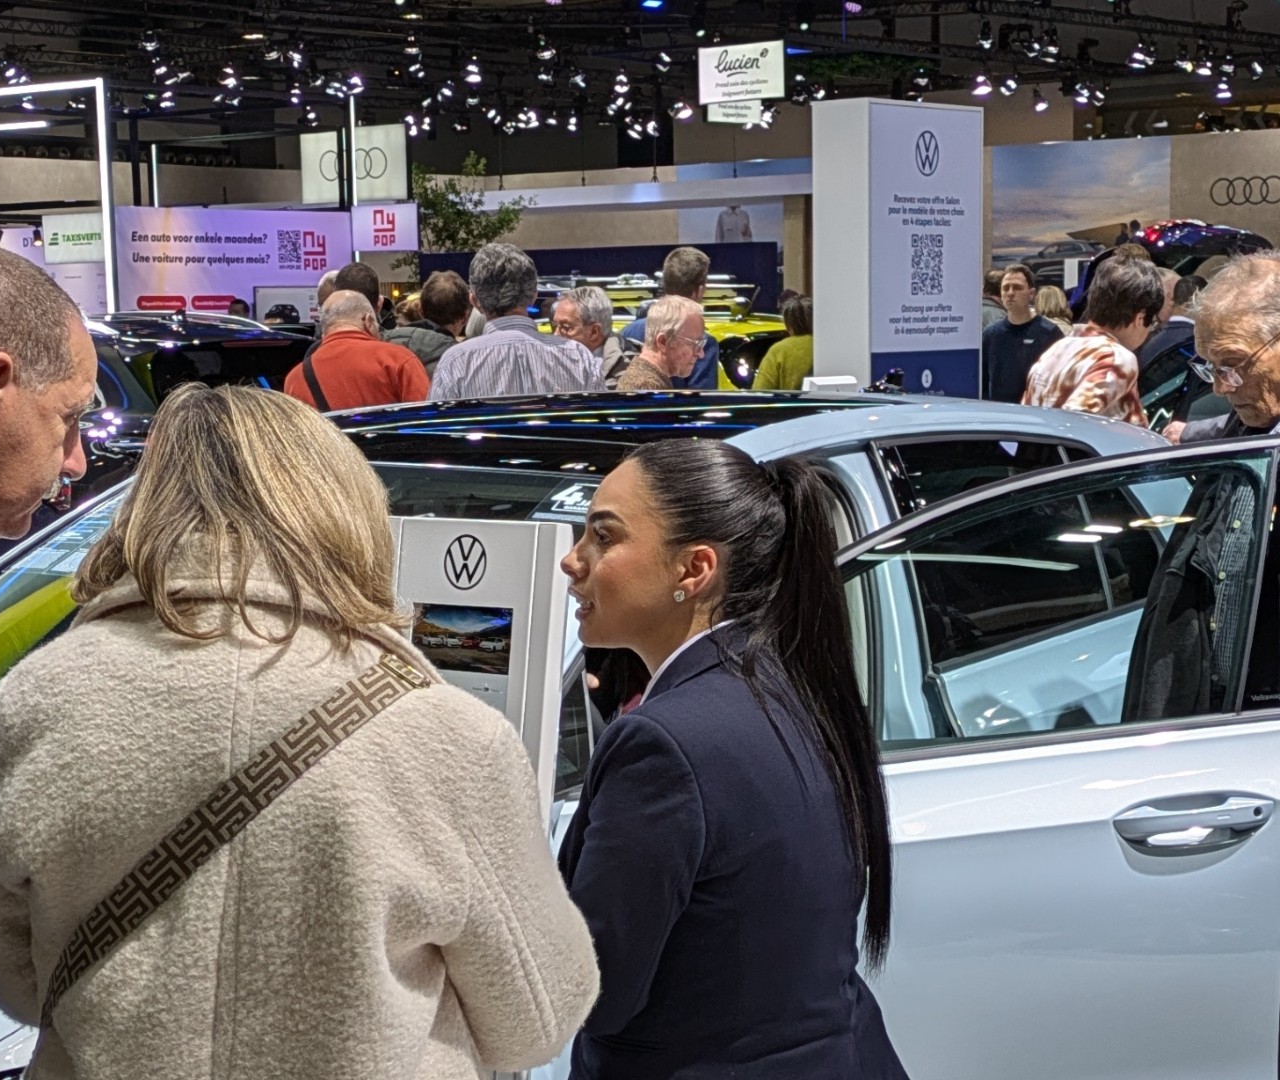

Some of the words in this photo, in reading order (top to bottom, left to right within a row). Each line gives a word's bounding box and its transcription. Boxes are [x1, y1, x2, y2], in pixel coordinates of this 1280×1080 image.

[714, 49, 761, 73] lucien
[62, 232, 102, 243] TAXISVERTS
[131, 231, 149, 243] Een
[150, 233, 171, 243] auto
[173, 234, 193, 243] voor
[194, 232, 223, 244] enkele
[224, 233, 268, 244] maanden?
[373, 234, 396, 246] POP
[132, 252, 150, 263] Une
[152, 253, 183, 263] voiture
[185, 255, 205, 266] pour
[207, 253, 245, 266] quelques
[246, 254, 271, 264] mois?
[303, 258, 327, 271] POP
[550, 485, 585, 506] 4
